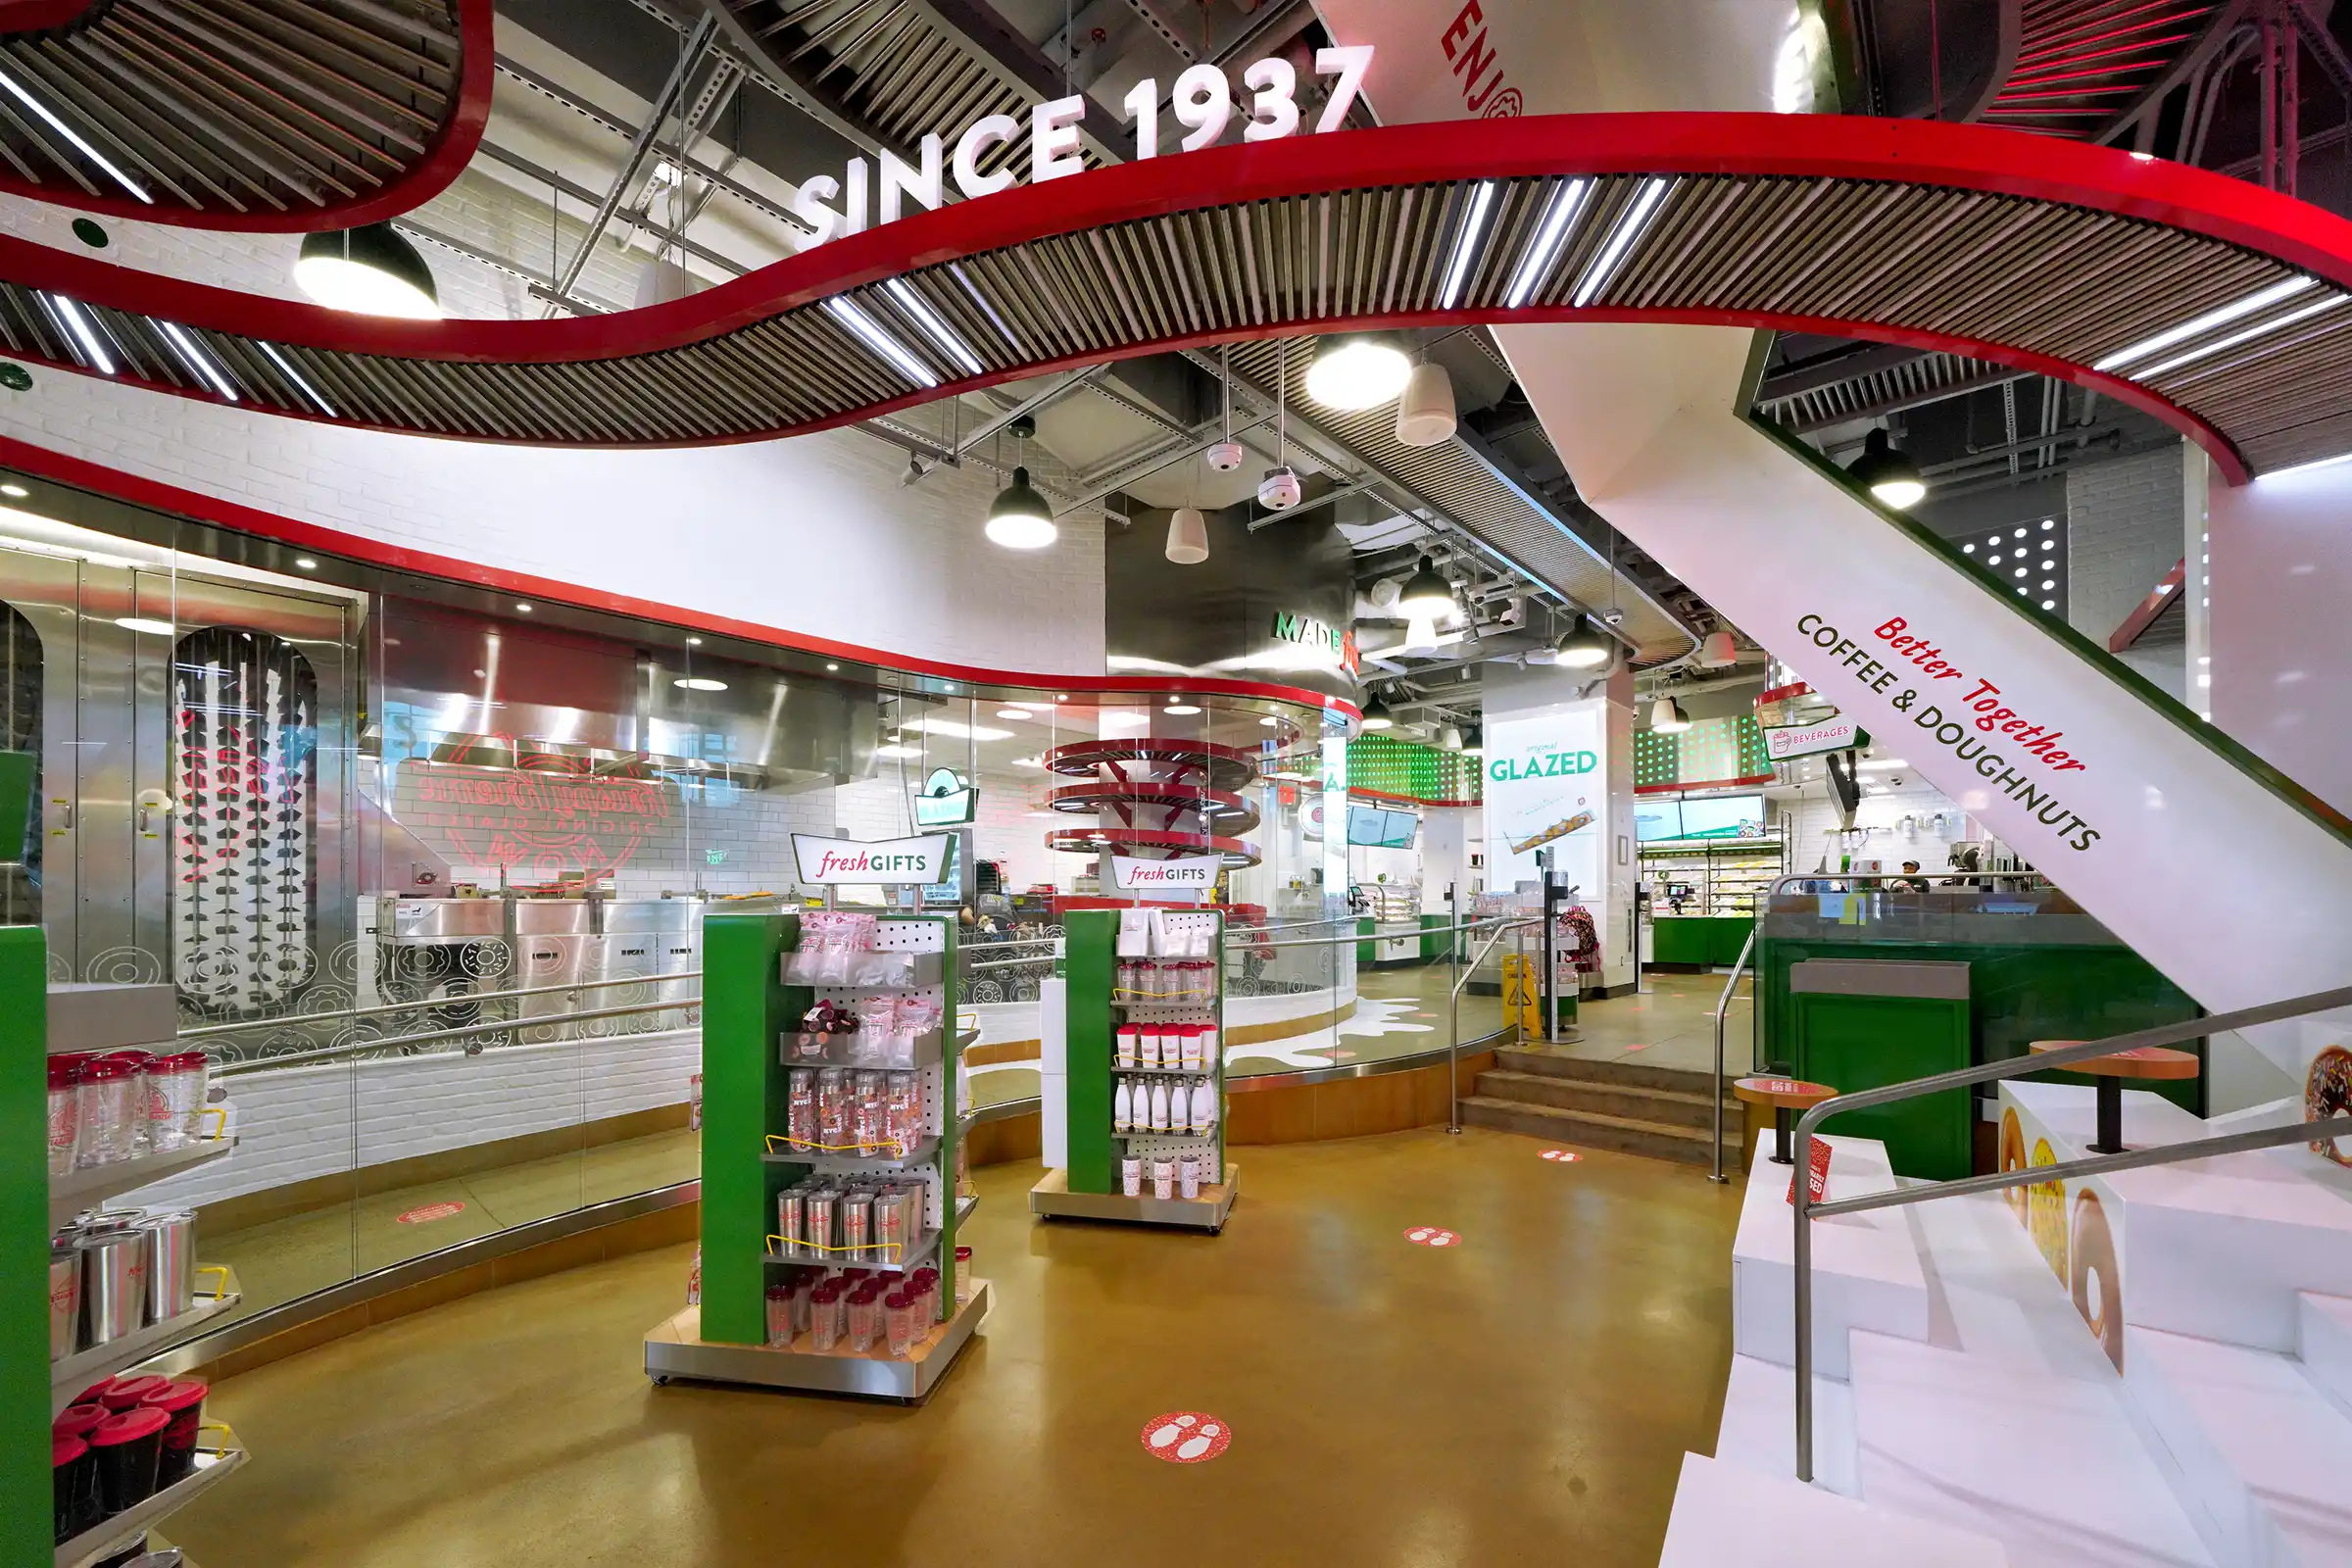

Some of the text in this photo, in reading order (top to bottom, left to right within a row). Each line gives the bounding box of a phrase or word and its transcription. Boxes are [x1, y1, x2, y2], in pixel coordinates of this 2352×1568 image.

[795, 45, 1374, 254] SINCE 1937
[1793, 725, 1850, 745] BEVERAGES
[1797, 613, 2102, 852] COFFEE & DOUGHNUTS
[1874, 616, 2086, 771] Better Together
[1490, 750, 1597, 782] GLAZED
[1809, 1178, 1823, 1194] SED
